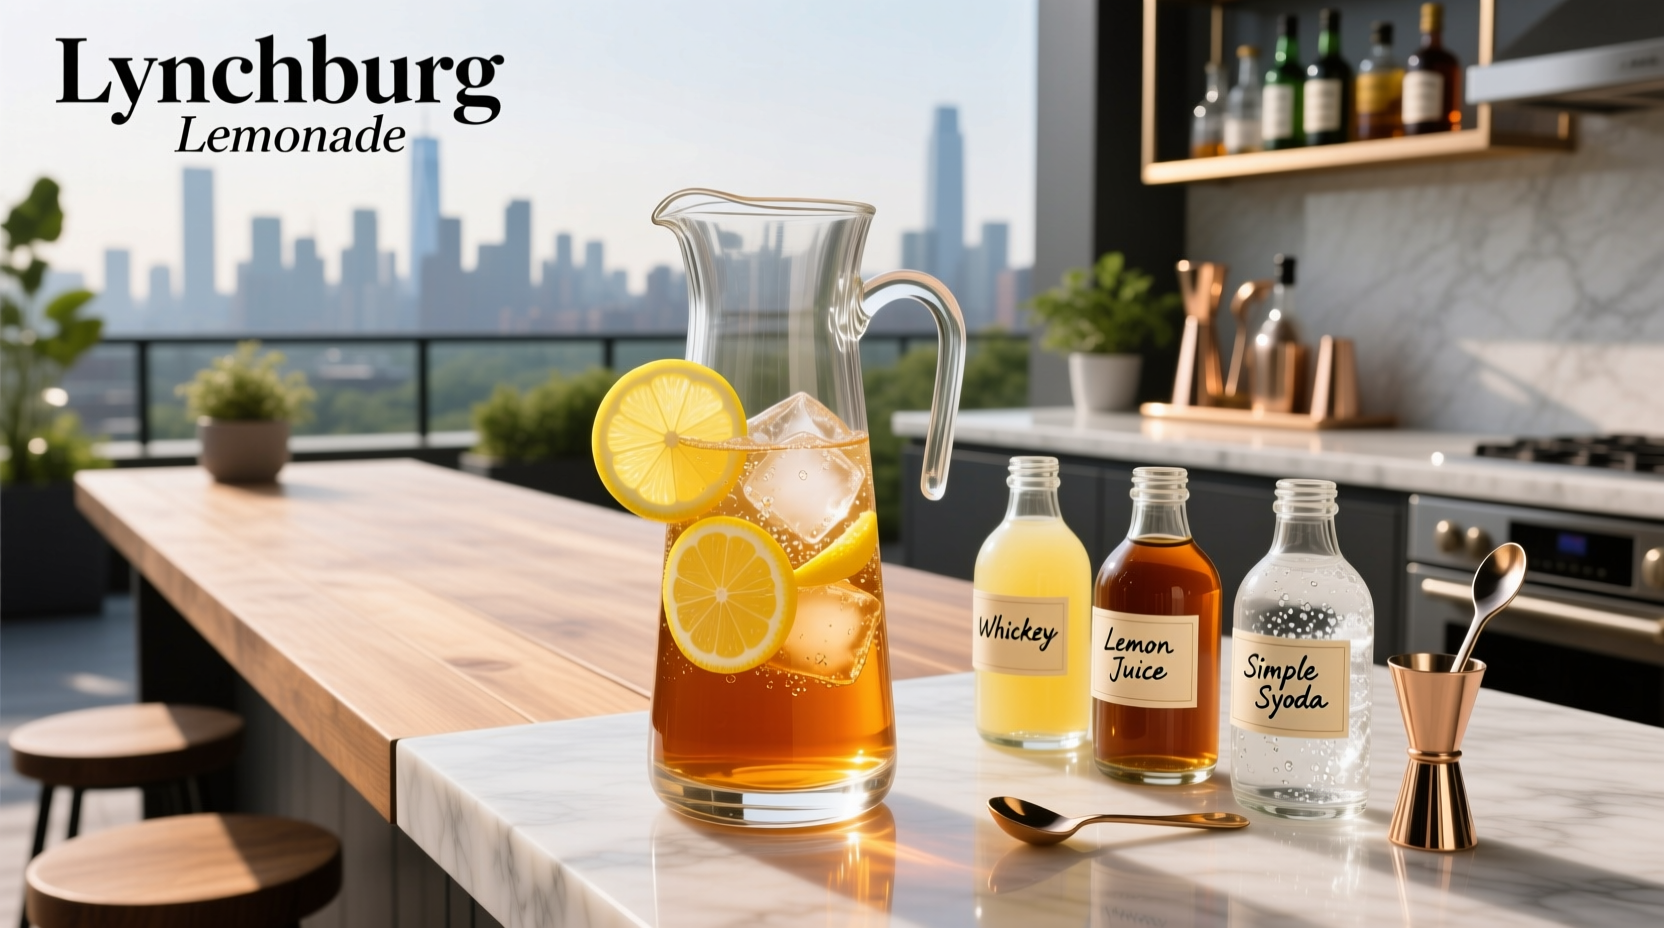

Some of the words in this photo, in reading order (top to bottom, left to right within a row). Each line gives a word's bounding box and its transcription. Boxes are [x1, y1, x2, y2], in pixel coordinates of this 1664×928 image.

[978, 614, 1059, 651] Whickey
[1104, 626, 1174, 655] Lemon
[1109, 656, 1168, 683] Juice
[1243, 653, 1319, 691] Simple
[1254, 684, 1329, 720] Syoda
